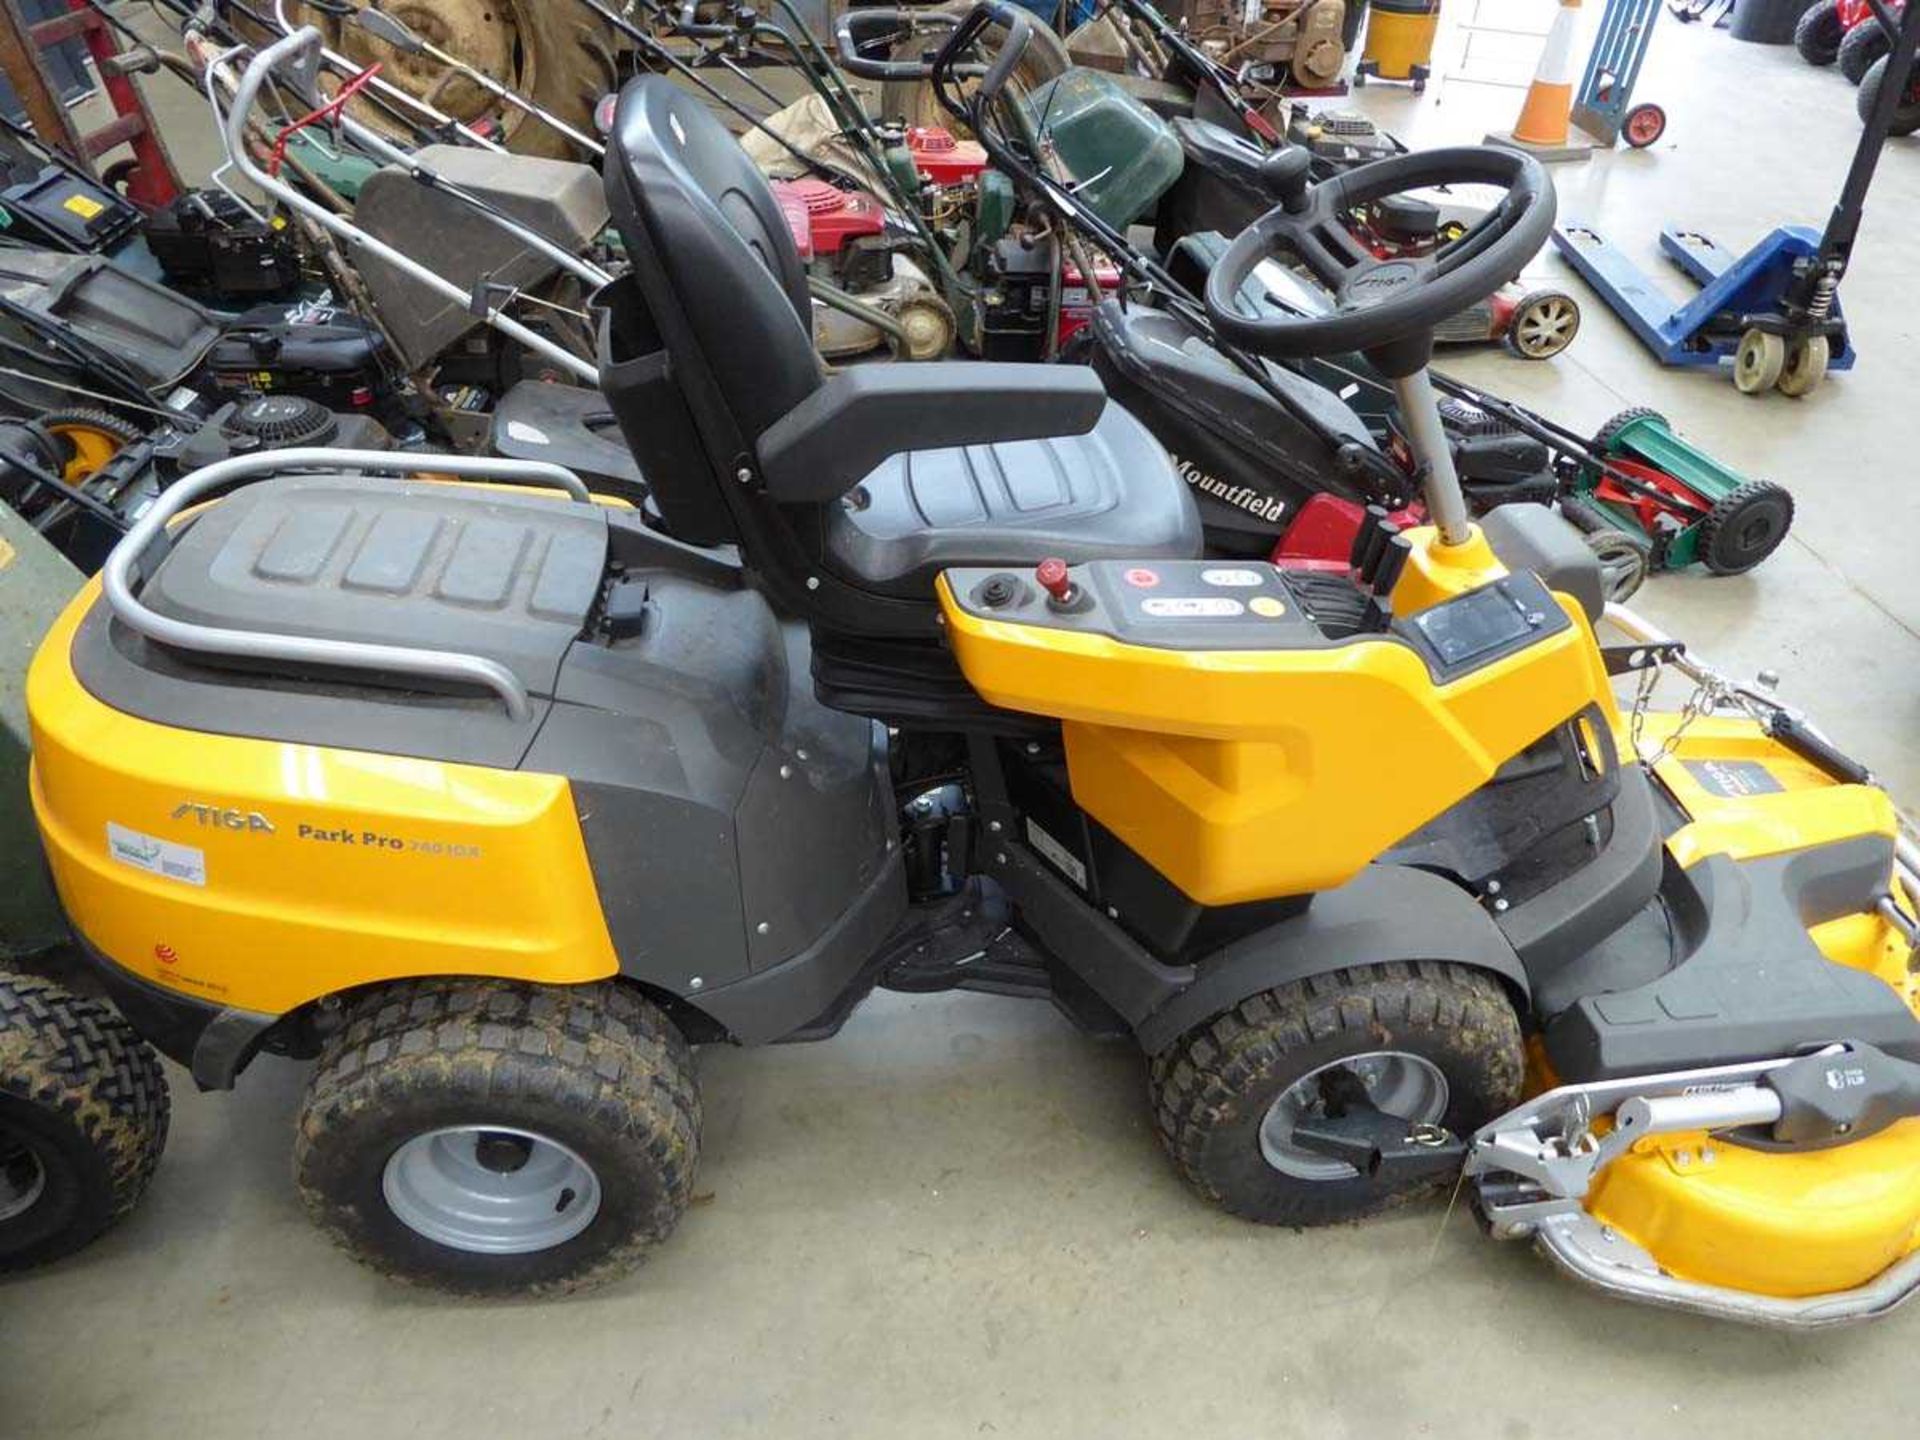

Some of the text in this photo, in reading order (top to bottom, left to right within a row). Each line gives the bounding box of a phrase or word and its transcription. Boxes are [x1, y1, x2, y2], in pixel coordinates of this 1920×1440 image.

[1172, 453, 1285, 521] Mountfield
[173, 802, 275, 832] STIGA
[298, 824, 354, 844] Park
[362, 832, 403, 850] Pro
